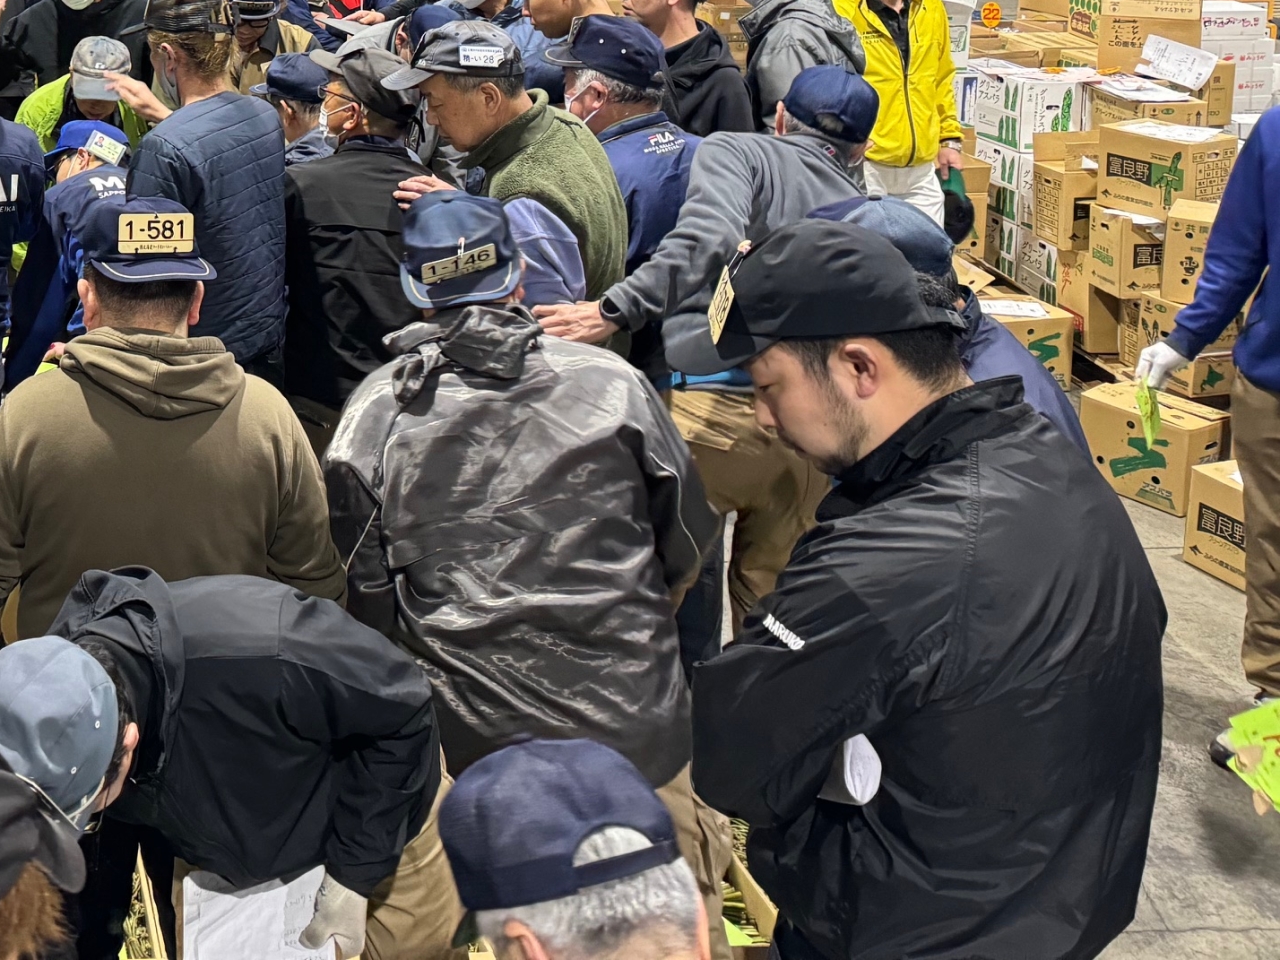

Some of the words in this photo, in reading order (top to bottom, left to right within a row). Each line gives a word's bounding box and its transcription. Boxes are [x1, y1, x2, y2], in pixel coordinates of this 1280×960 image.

[983, 7, 1000, 20] 22
[978, 78, 1002, 93] グリーン
[978, 90, 1001, 104] アスパラ
[648, 131, 675, 145] FILA
[977, 148, 999, 164] グリーン
[1109, 155, 1150, 182] 富良野
[88, 175, 126, 191] M
[125, 219, 185, 240] 1-581
[1021, 240, 1044, 258] グリーン
[428, 249, 490, 276] 1-146
[1021, 251, 1043, 270] アスパラ
[1141, 481, 1173, 499] アスパラ
